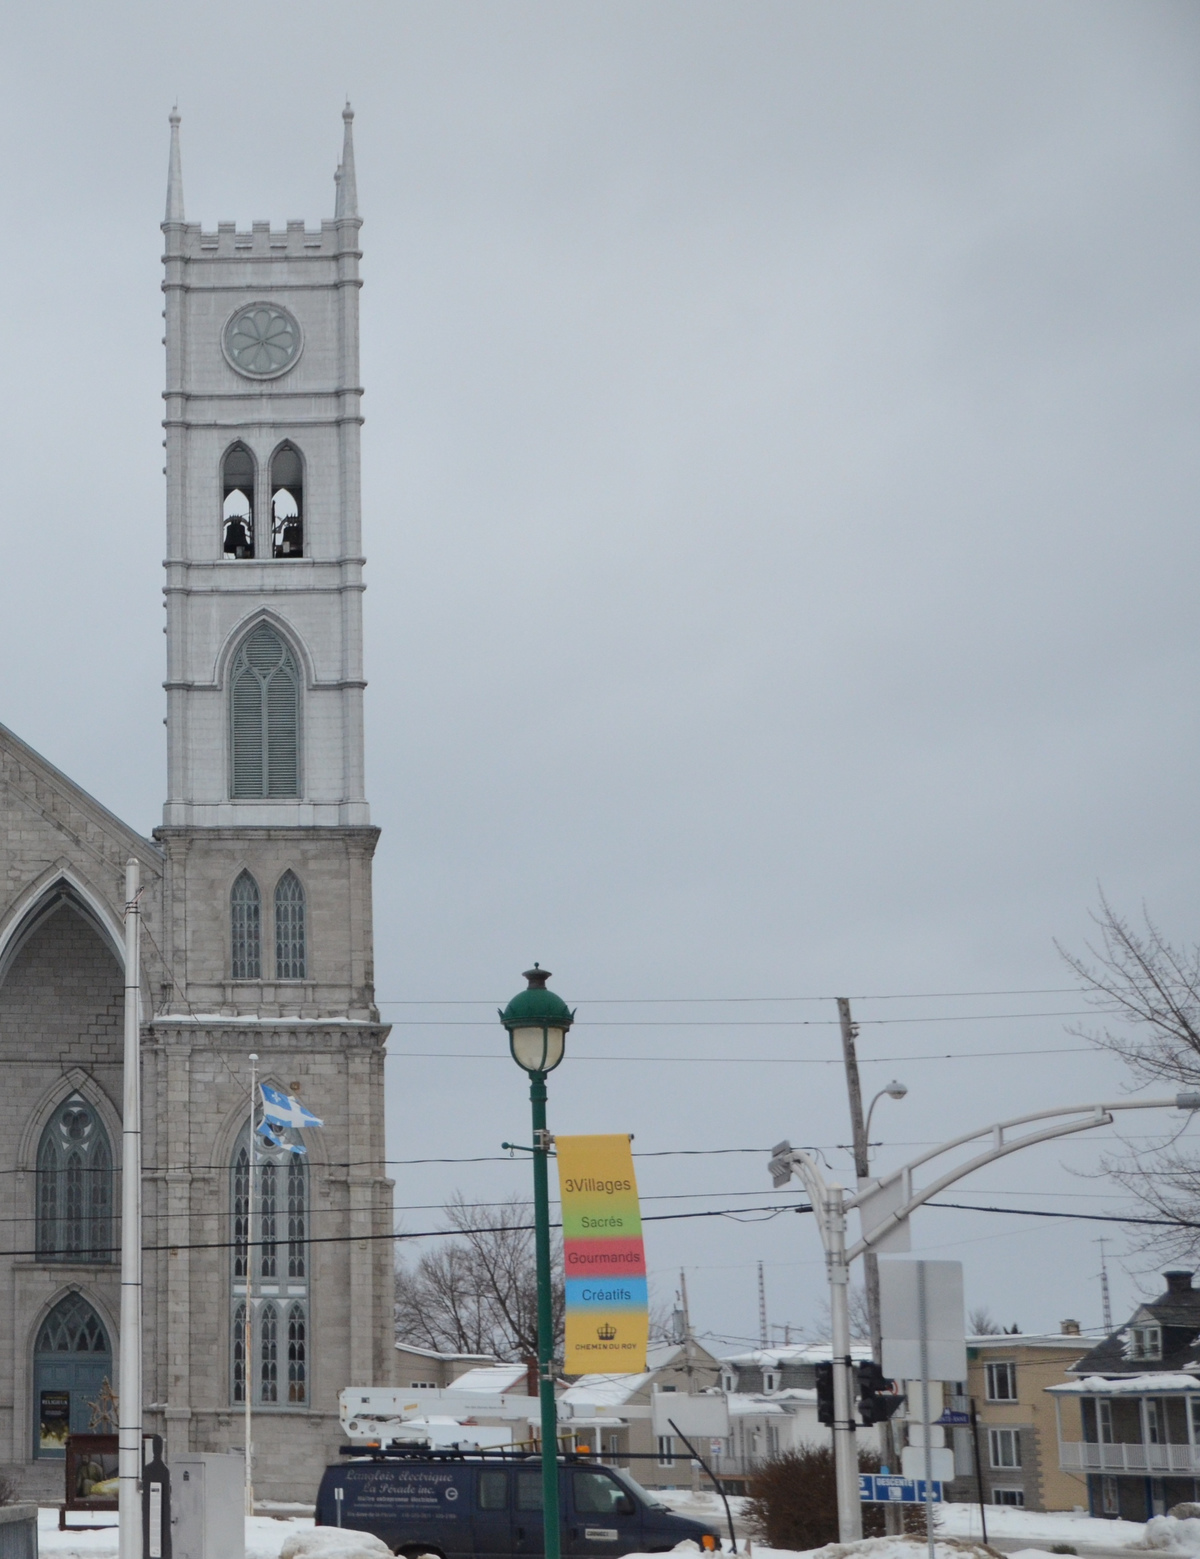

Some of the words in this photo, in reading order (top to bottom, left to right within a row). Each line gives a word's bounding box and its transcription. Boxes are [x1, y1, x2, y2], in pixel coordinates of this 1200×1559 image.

[565, 1178, 631, 1194] 3Villages
[581, 1216, 623, 1228] Sacrés
[568, 1251, 640, 1264] Gourmands
[582, 1288, 631, 1300] Créatifs
[346, 1469, 395, 1482] Langlois
[398, 1470, 453, 1485] électrique
[363, 1483, 376, 1494] La
[379, 1483, 415, 1494] Pérade
[417, 1486, 435, 1494] inc.
